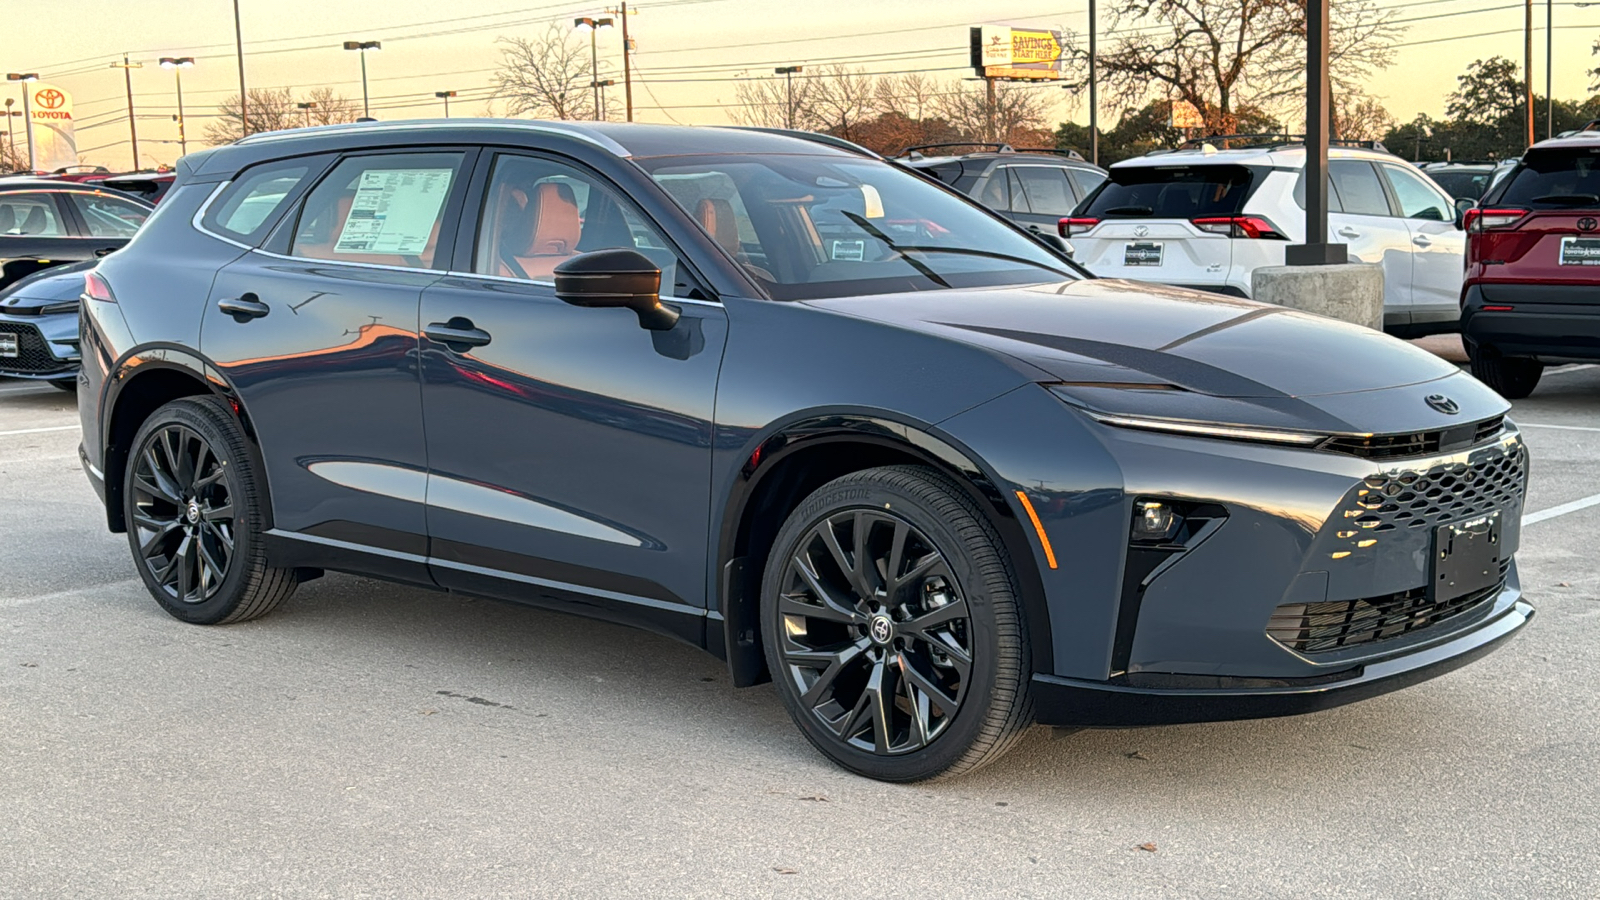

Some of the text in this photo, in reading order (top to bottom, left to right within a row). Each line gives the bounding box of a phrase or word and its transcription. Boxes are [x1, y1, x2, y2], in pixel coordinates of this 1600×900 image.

[1013, 36, 1052, 50] SAVINGS
[1012, 50, 1034, 58] START
[1035, 50, 1052, 60] HERE
[31, 111, 72, 120] TOYOTA
[801, 488, 870, 521] BRIDGESTONE
